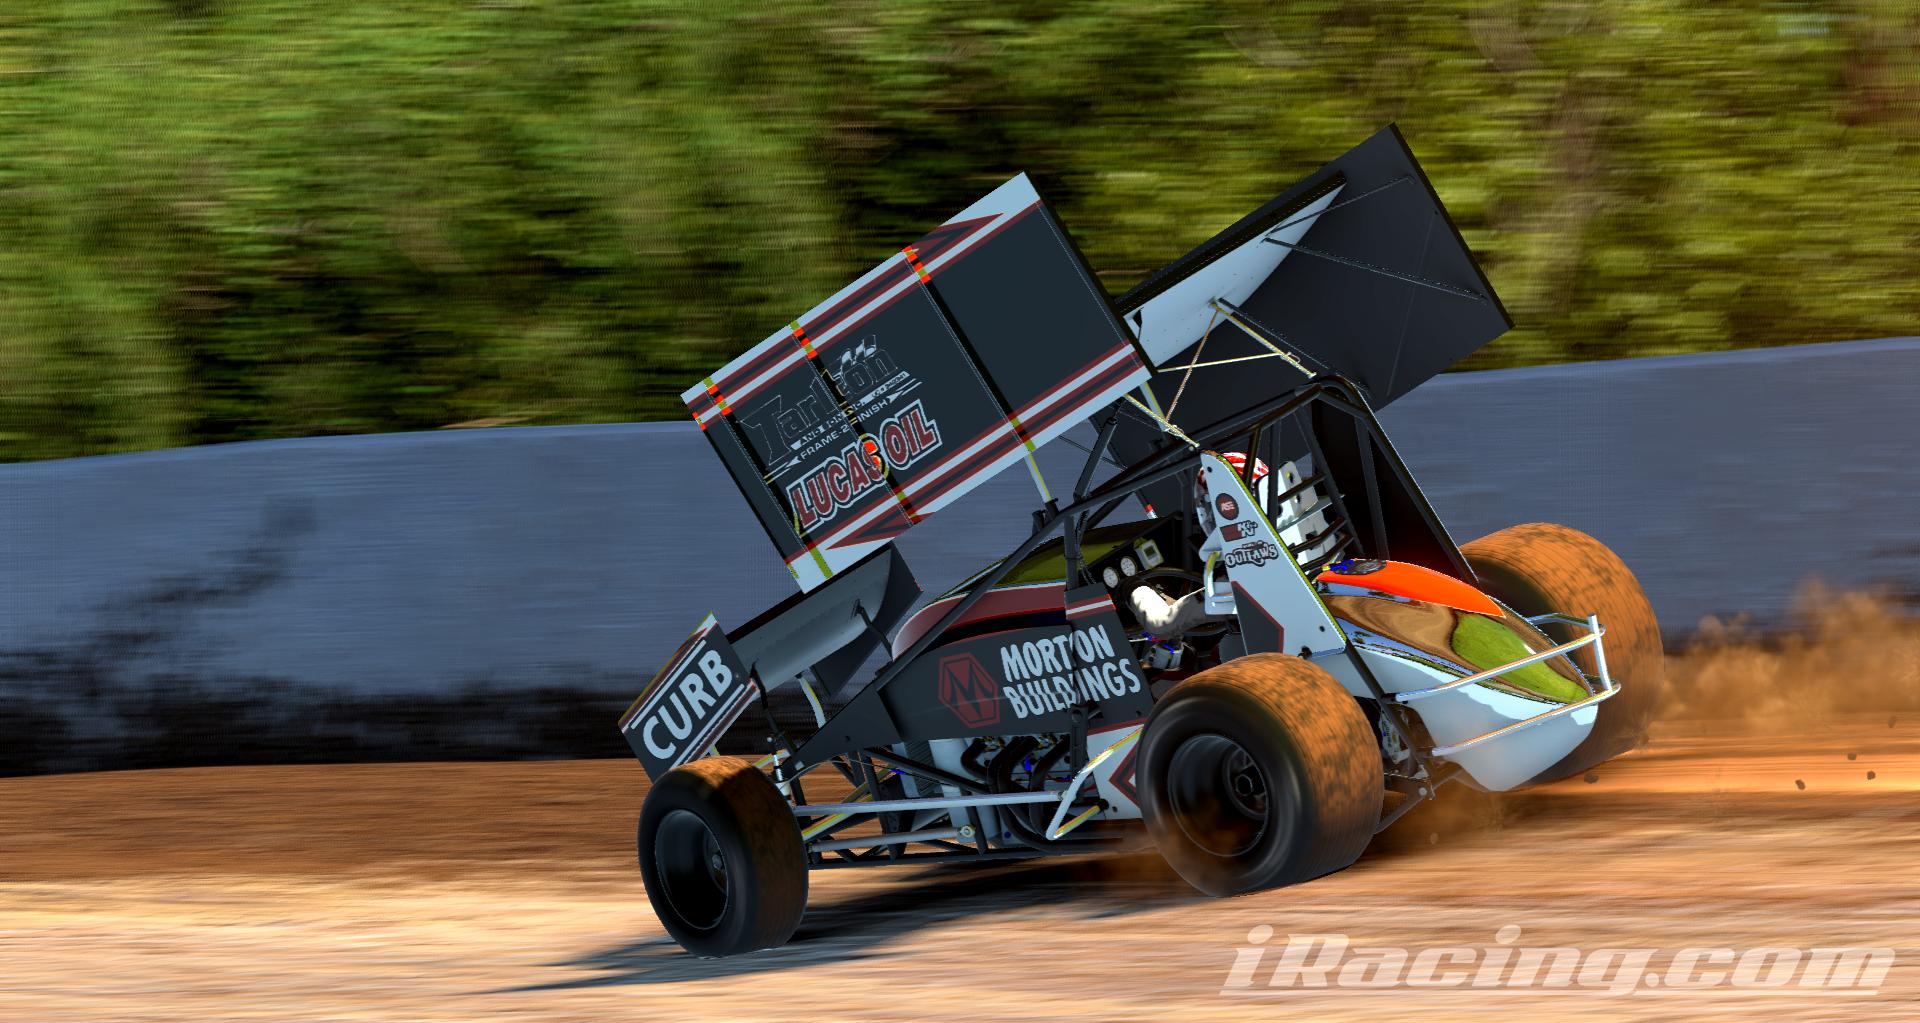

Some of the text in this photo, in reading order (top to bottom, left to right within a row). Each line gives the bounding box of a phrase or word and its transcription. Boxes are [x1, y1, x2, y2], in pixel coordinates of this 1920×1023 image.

[789, 436, 886, 531] LUCAS
[881, 404, 940, 468] OIL
[1225, 544, 1278, 568] OUTLAWS
[1001, 624, 1115, 682] MORTON
[643, 650, 732, 759] CURB
[1003, 658, 1141, 719] BUILDINGS
